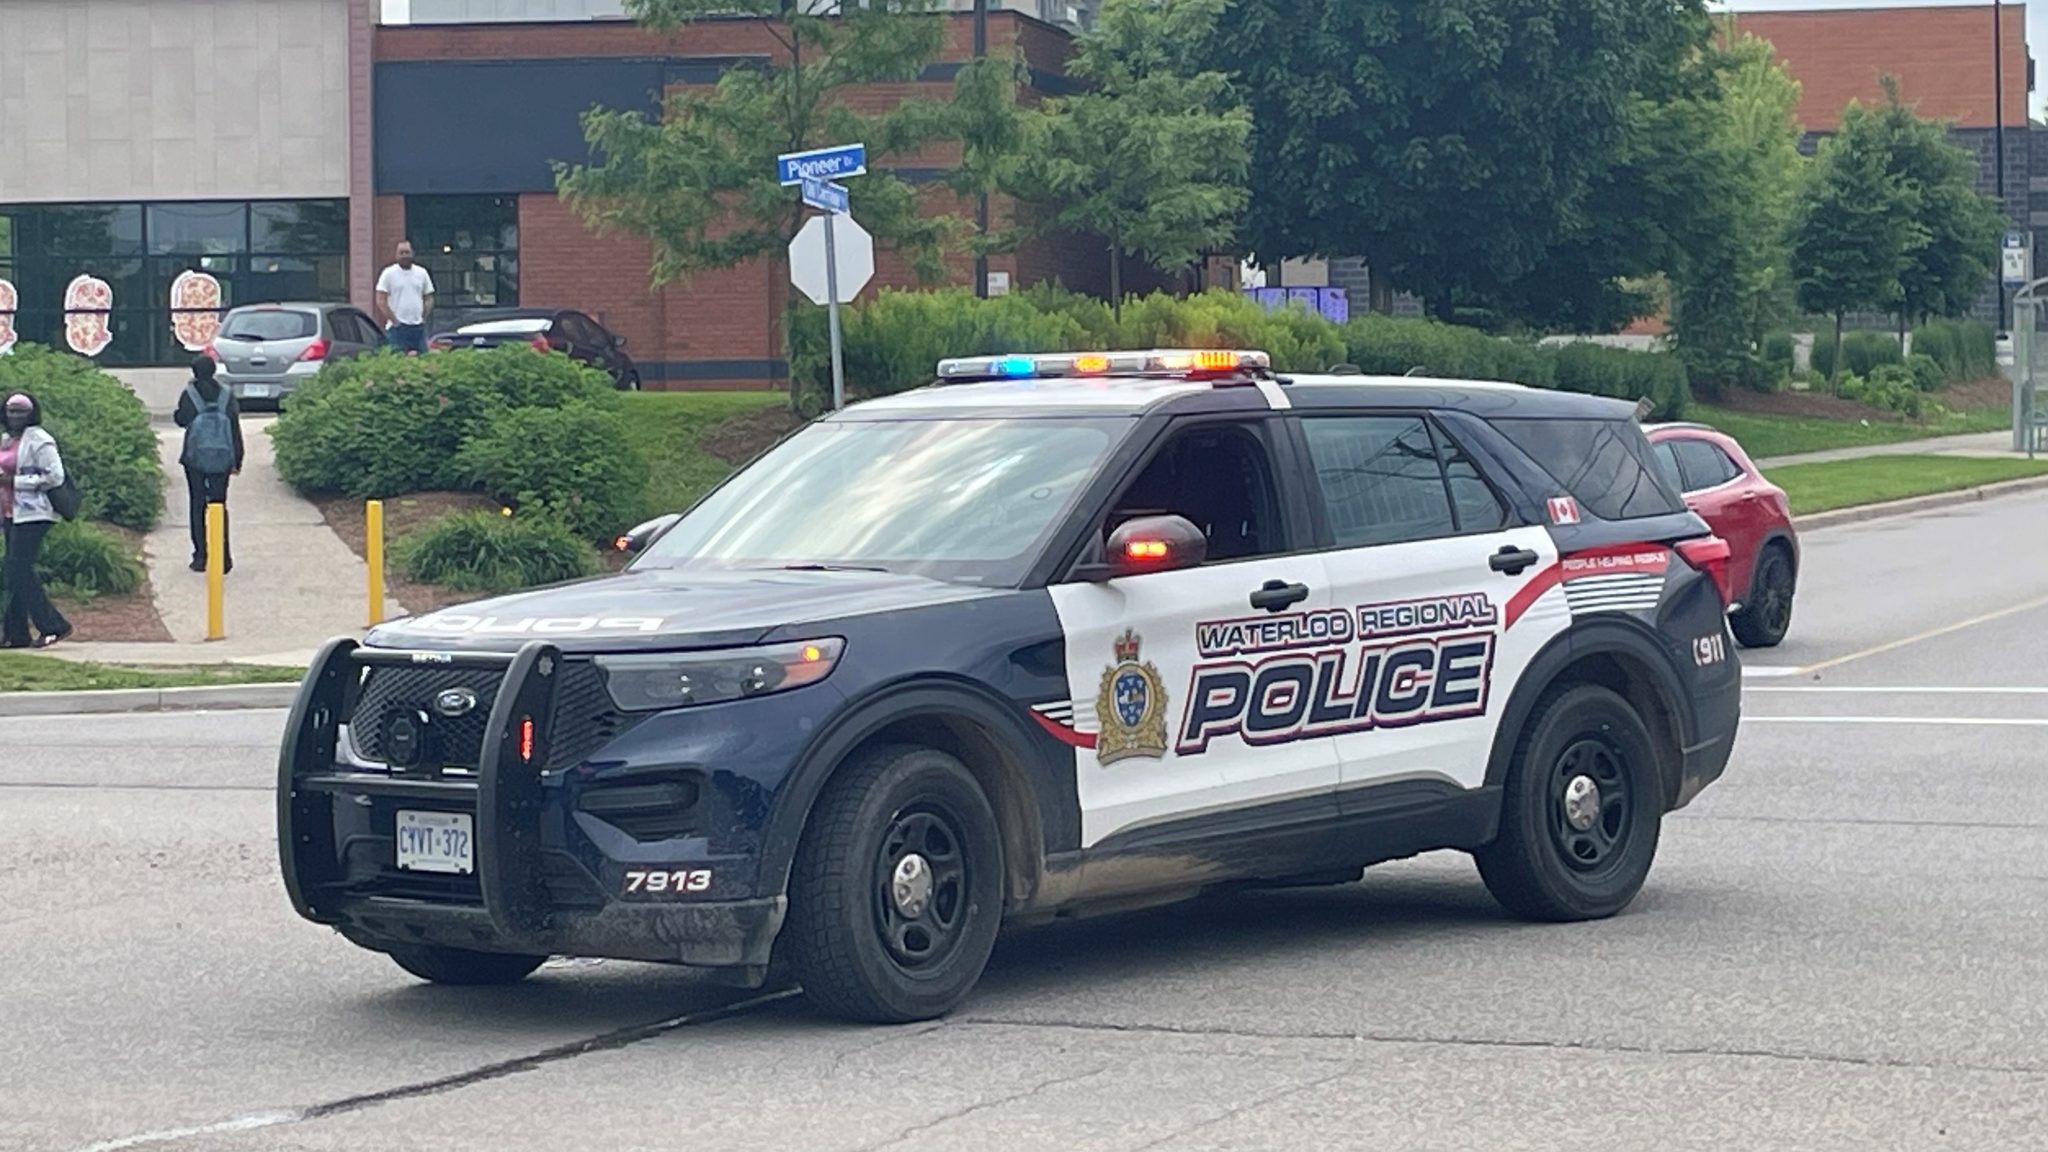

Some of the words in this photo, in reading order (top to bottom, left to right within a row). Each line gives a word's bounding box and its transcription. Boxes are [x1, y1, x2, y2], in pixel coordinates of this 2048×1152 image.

[787, 157, 842, 178] Pioneer
[1199, 612, 1351, 654] WATERLOO
[1359, 594, 1496, 637] REGIONAL
[1180, 634, 1494, 751] POLICE
[625, 868, 713, 892] 7913
